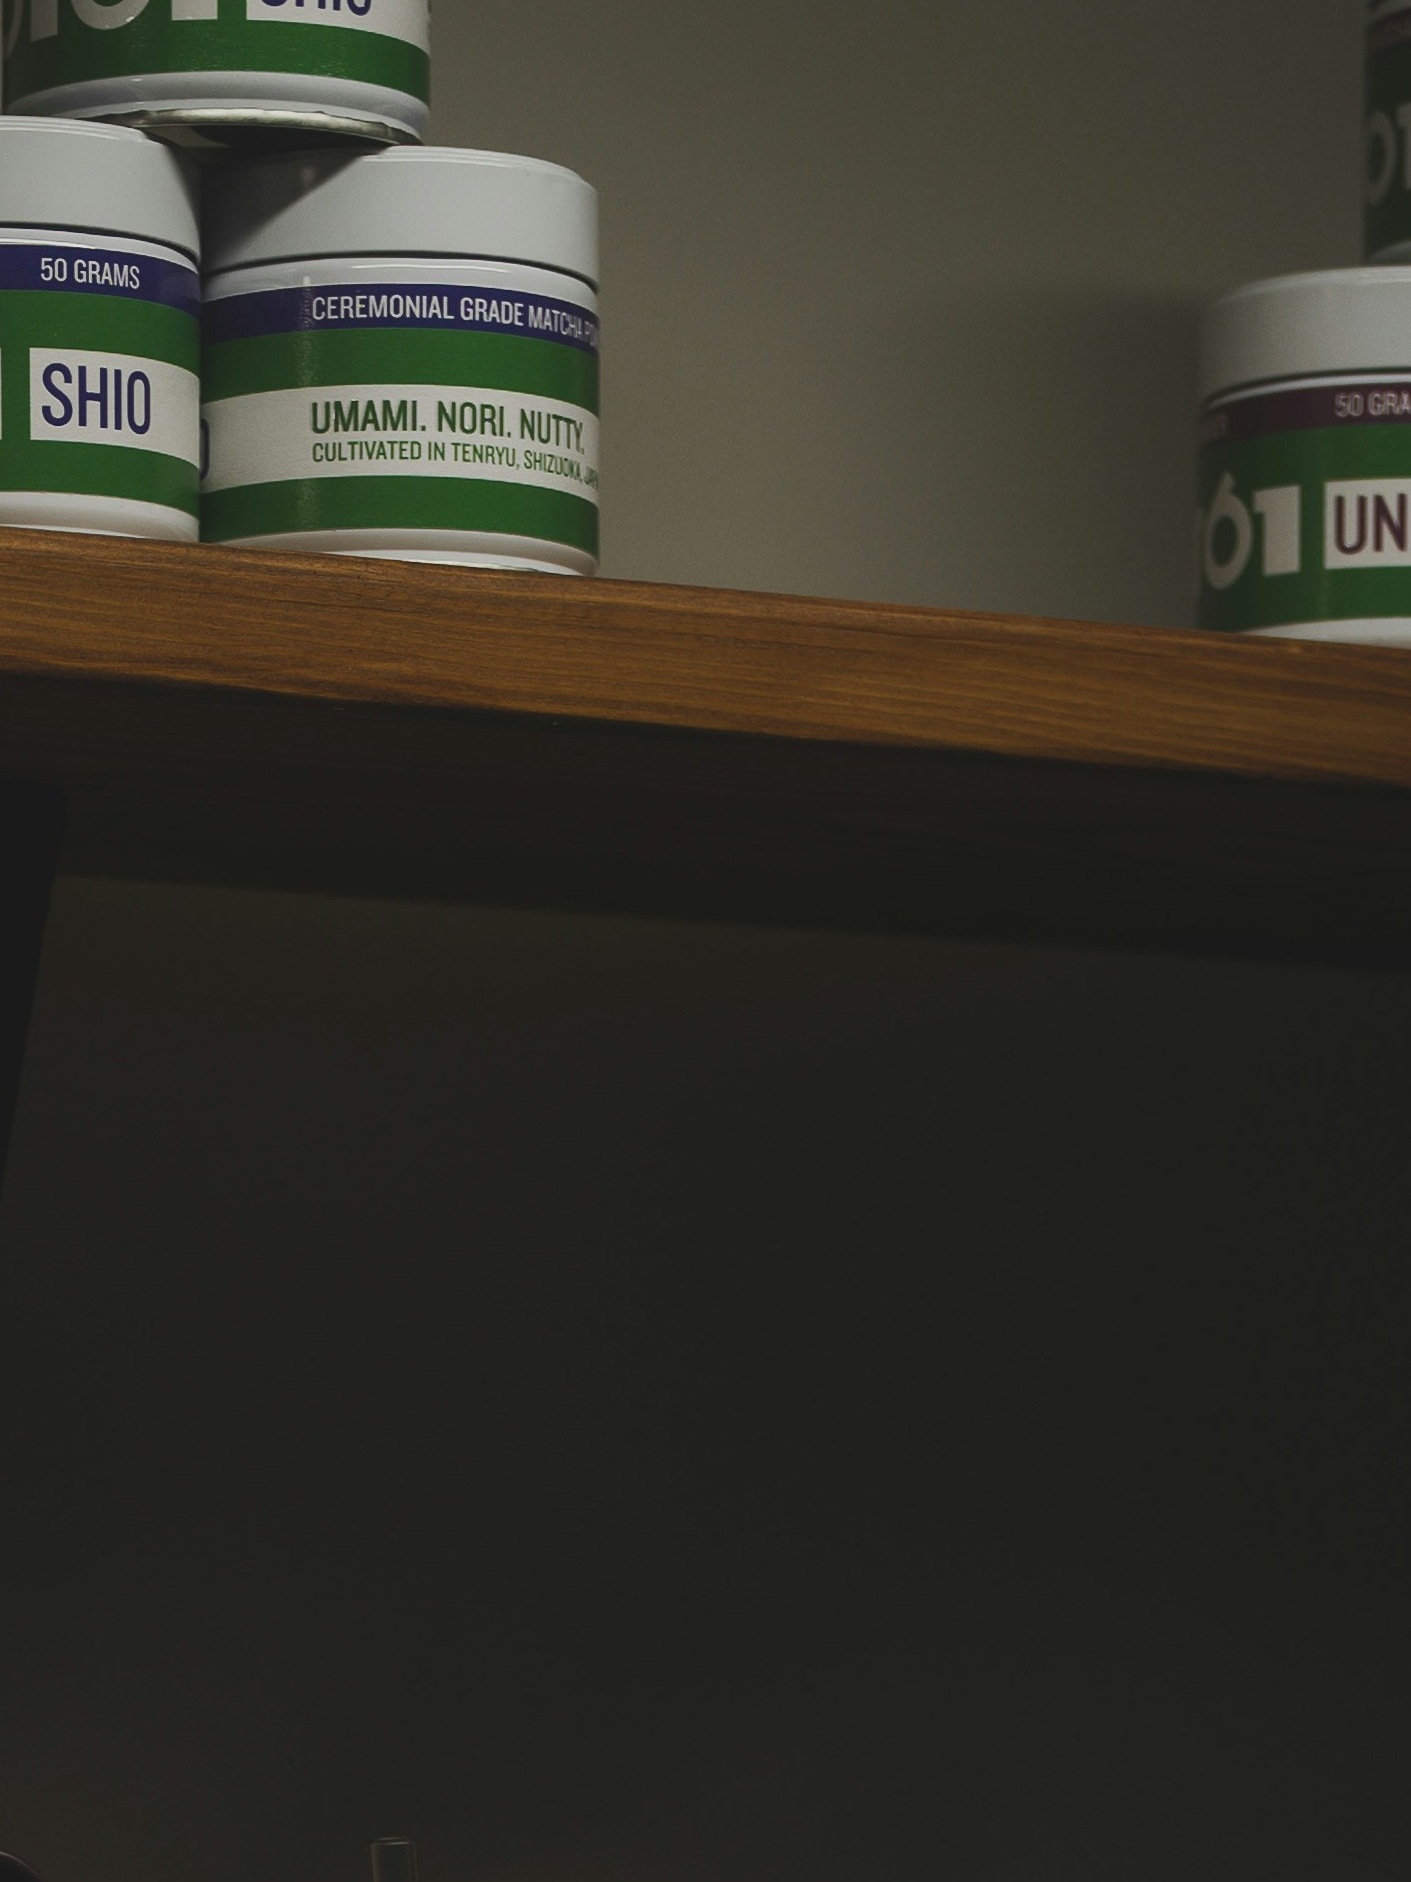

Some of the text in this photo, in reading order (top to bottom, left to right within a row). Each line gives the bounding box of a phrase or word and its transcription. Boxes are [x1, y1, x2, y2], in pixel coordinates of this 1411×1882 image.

[40, 258, 141, 290] 50 GRAMS
[311, 294, 454, 321] CEREMONIAL
[460, 297, 524, 327] GRADE
[41, 362, 151, 435] SHIO
[1334, 391, 1364, 418] 50
[311, 400, 585, 455] UMAMI. NORI. NUTTY.
[312, 441, 422, 463] CULTIVATED
[428, 442, 445, 460] IN
[451, 442, 520, 469] TENRYU,
